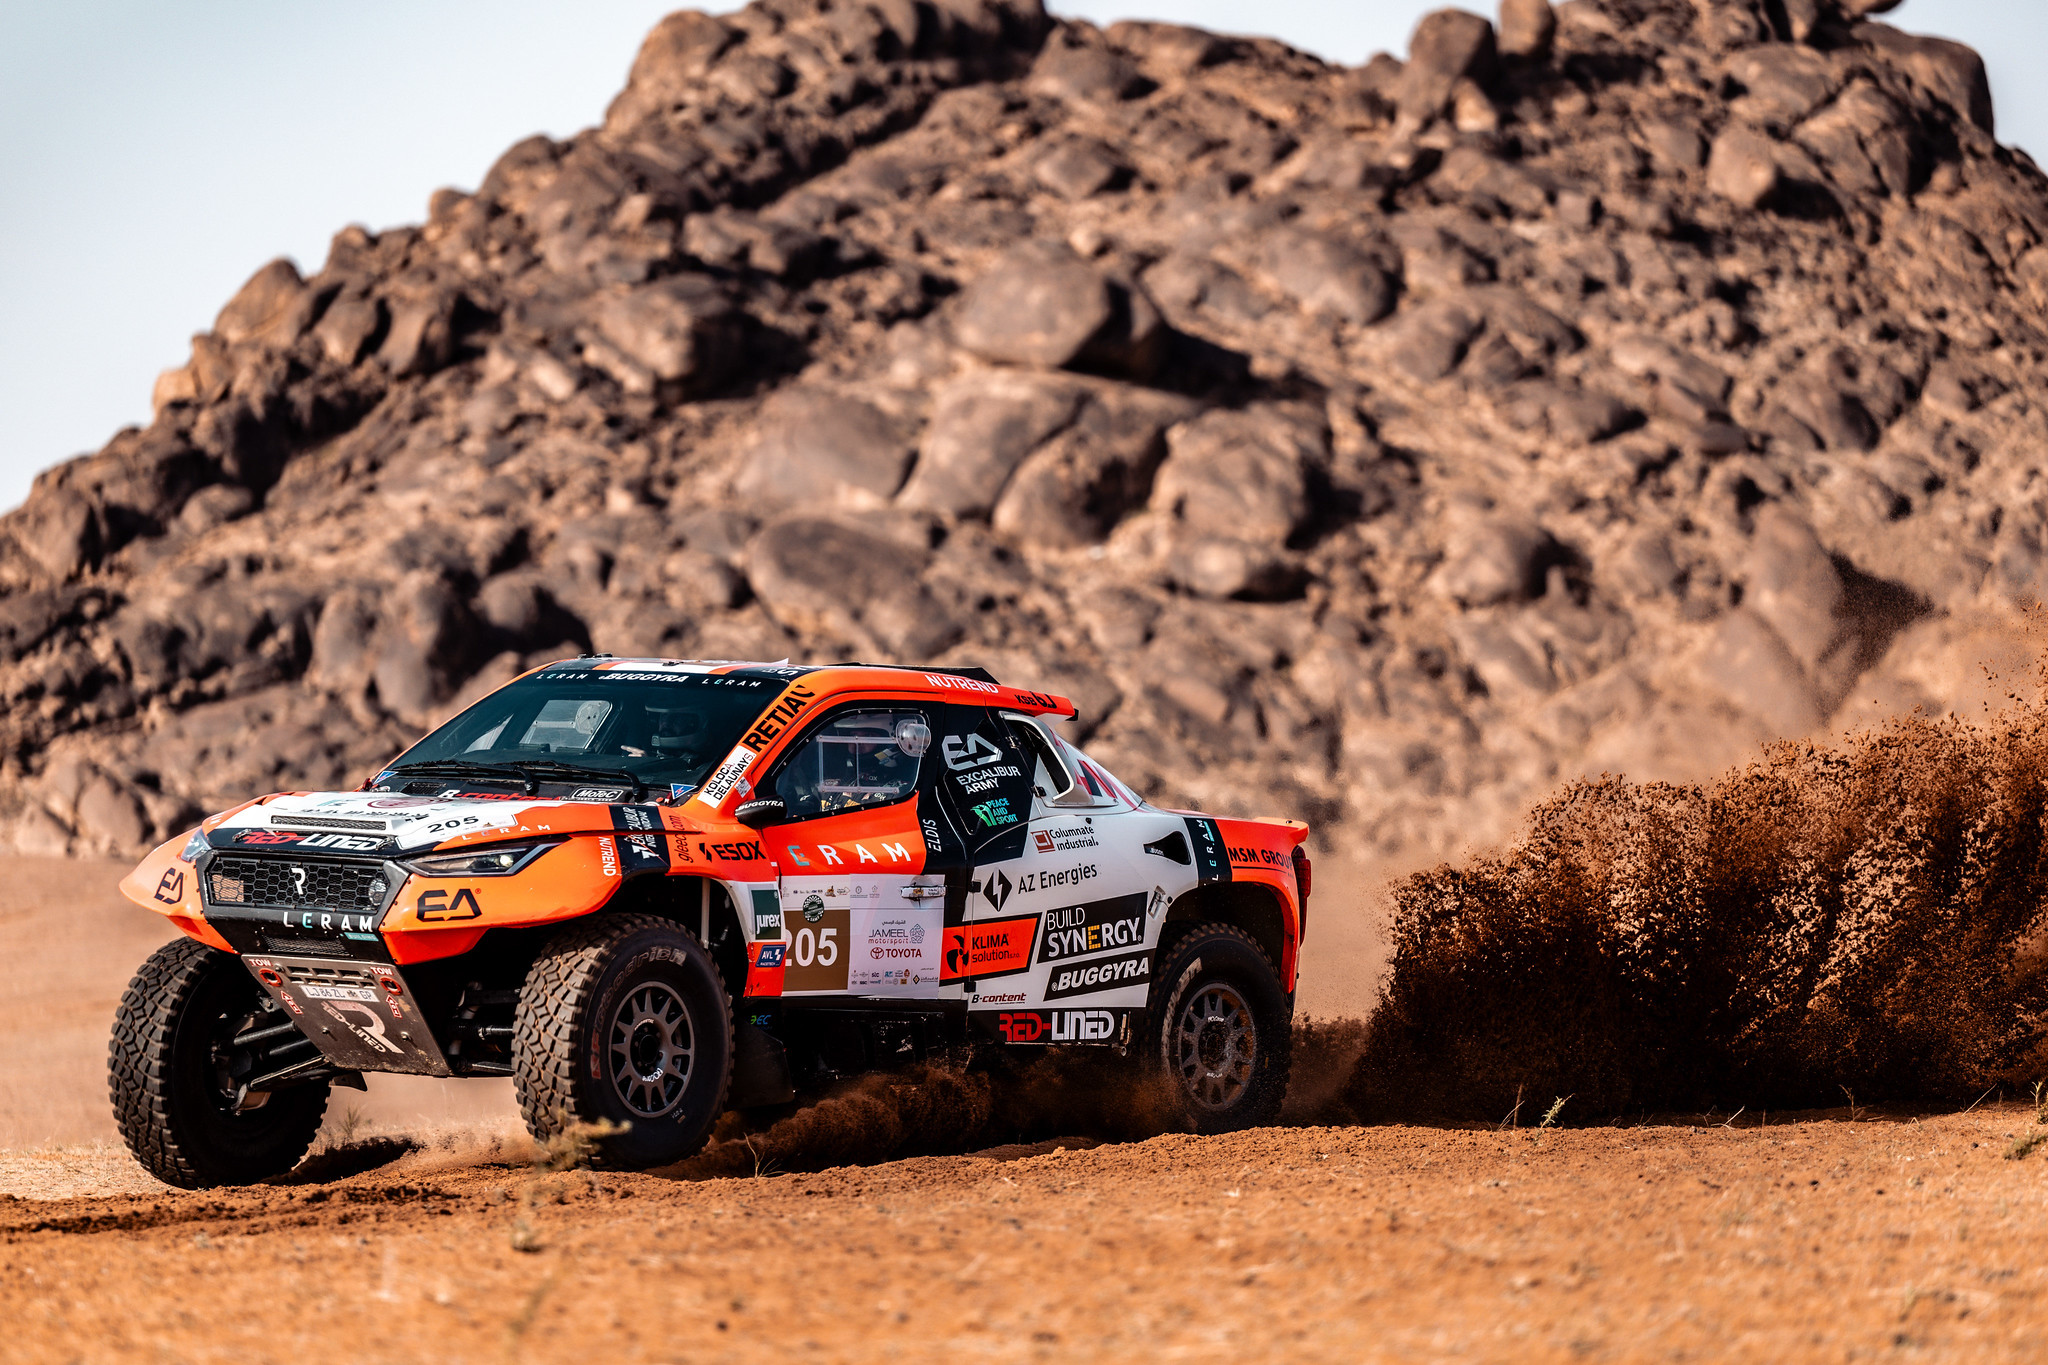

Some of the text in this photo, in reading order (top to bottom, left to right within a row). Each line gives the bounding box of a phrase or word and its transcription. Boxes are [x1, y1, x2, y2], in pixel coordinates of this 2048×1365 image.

[602, 673, 689, 683] BUGGYRA
[702, 678, 762, 688] LERAM
[925, 674, 999, 694] NUTREND
[956, 766, 1021, 785] EXCALIBUR
[965, 778, 1000, 794] ARMY
[736, 800, 784, 811] BUGGYRA
[987, 798, 1010, 808] PEACE
[992, 807, 1008, 816] AND
[996, 814, 1018, 825] SPORT
[427, 815, 480, 834] 205
[461, 824, 551, 841] LERAM
[1049, 825, 1094, 839] Columnate
[242, 831, 388, 851] RED-LINED
[598, 836, 617, 877] NUTREND
[712, 840, 767, 861] ESOX
[788, 842, 912, 867] ERAM
[1227, 847, 1294, 872] MSM GROUP
[1018, 862, 1098, 894] AZ Energies
[283, 911, 374, 931] LERAM
[756, 914, 780, 934] jurex
[1047, 907, 1086, 931] BUILD
[868, 929, 908, 938] JAMEEL
[972, 934, 1009, 950] KLIMA
[761, 951, 774, 960] AVL
[885, 949, 922, 958] TOYOTA
[972, 949, 1010, 963] solution
[249, 958, 273, 967] TOW
[370, 966, 393, 976] TOW
[1057, 957, 1149, 990] BUGGYRA
[360, 991, 373, 1000] GP
[972, 992, 1027, 1004] B-content
[999, 1010, 1115, 1041] RED-LINED
